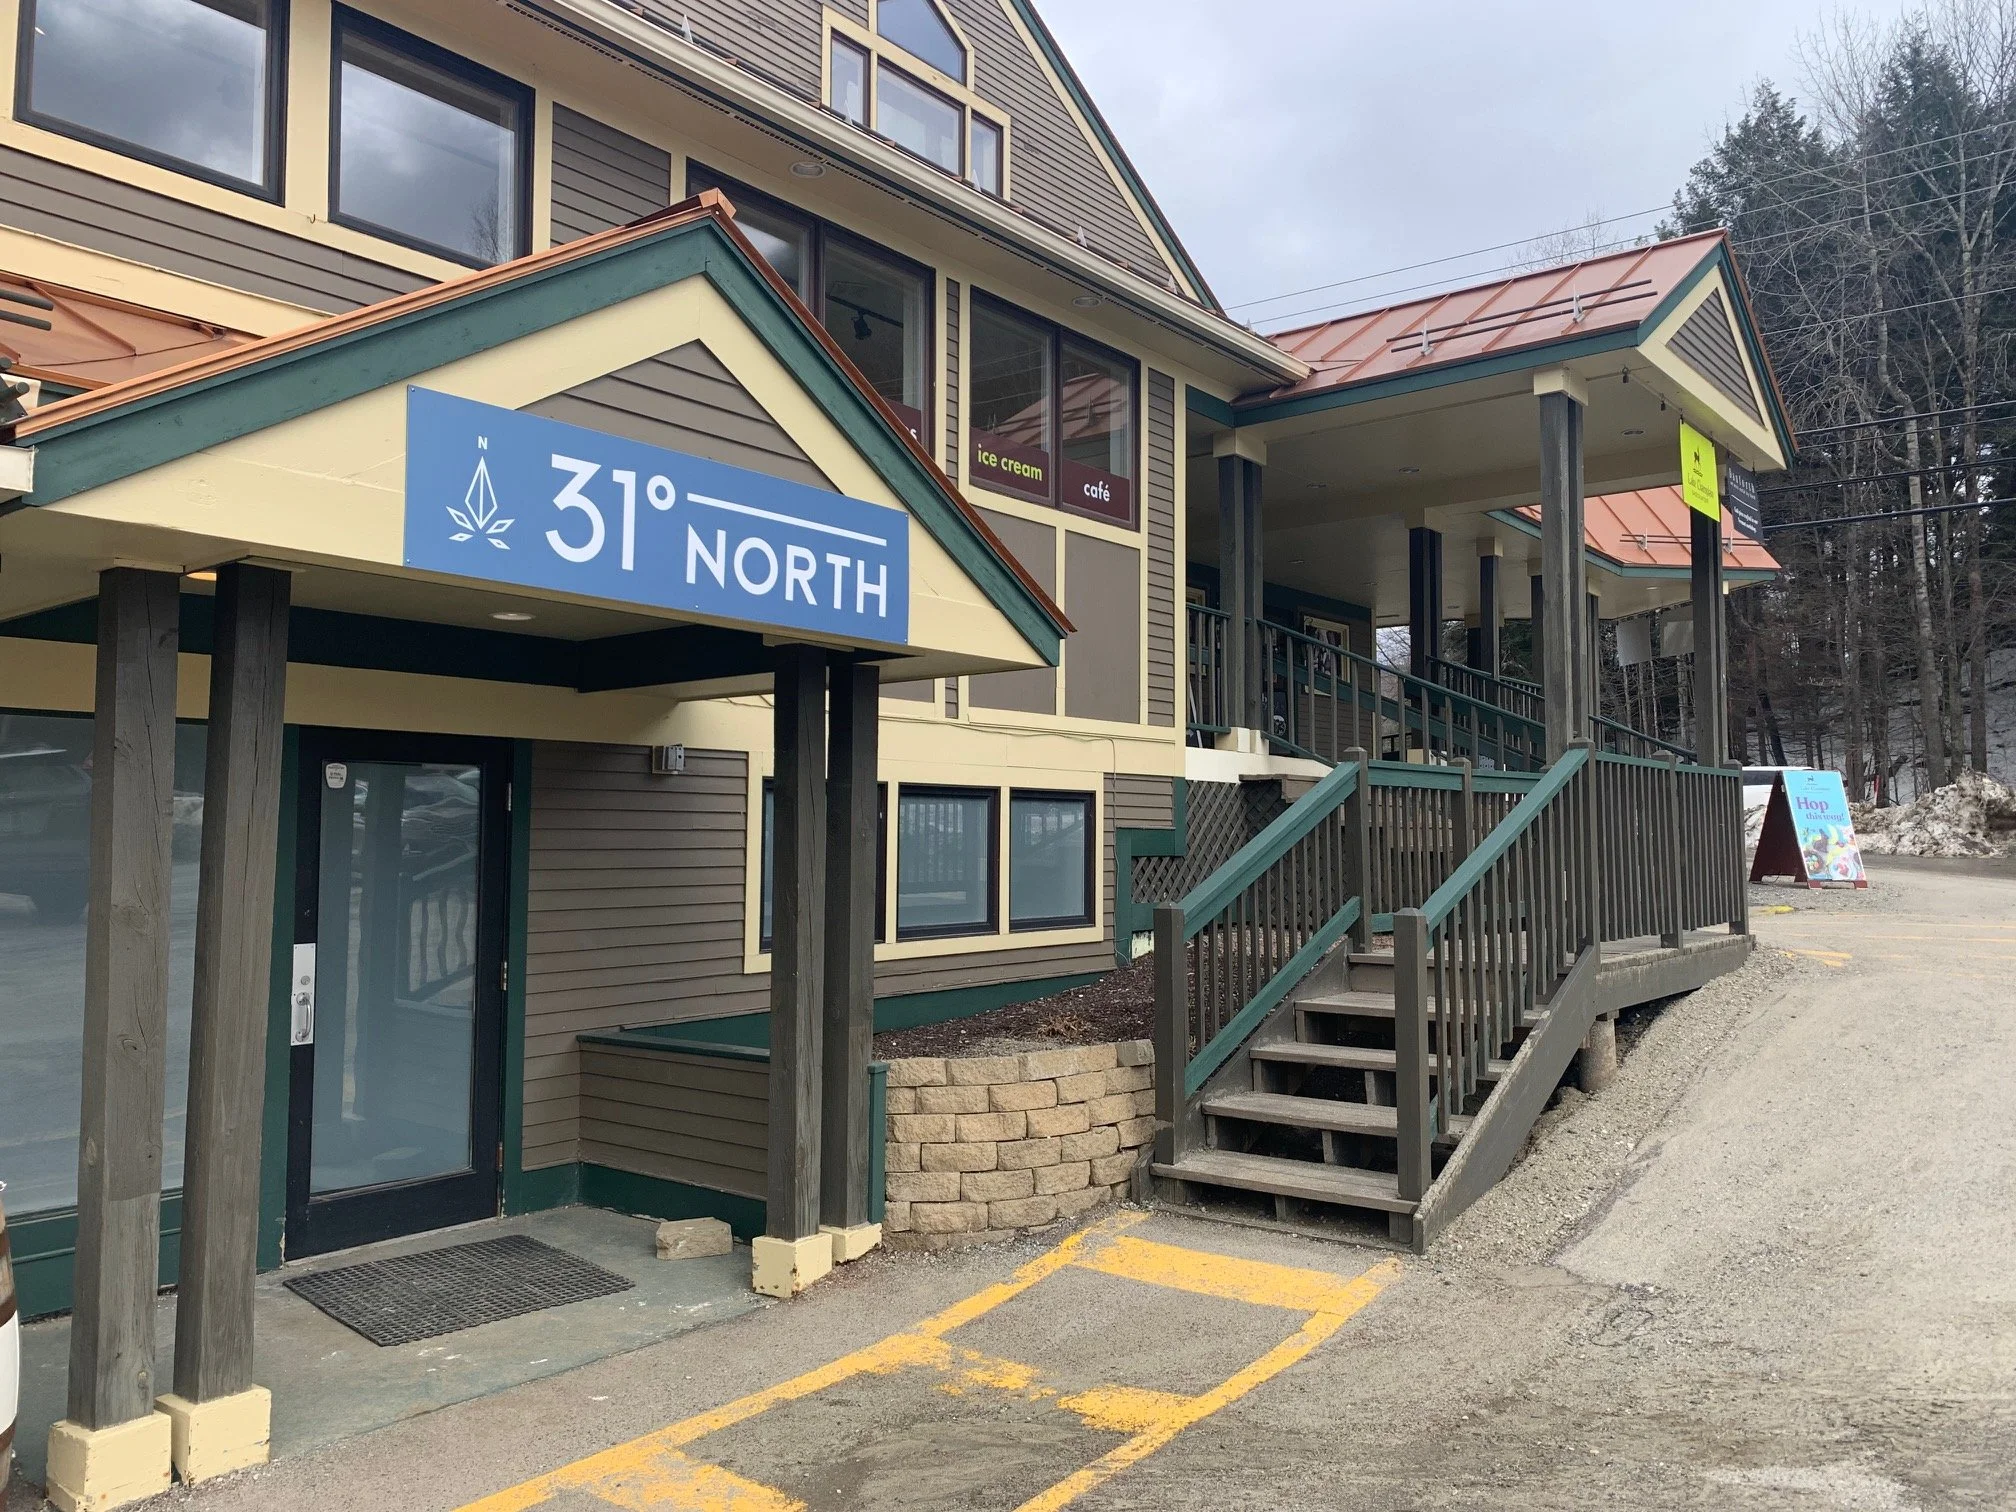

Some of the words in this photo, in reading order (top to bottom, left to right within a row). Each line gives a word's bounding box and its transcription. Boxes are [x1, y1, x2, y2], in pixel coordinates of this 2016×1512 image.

[477, 435, 488, 450] N
[977, 443, 997, 467] ice
[1000, 456, 1043, 482] cream
[1083, 480, 1110, 502] café
[686, 523, 887, 618] NORTH
[1795, 796, 1829, 813] Hop
[1806, 812, 1822, 820] this
